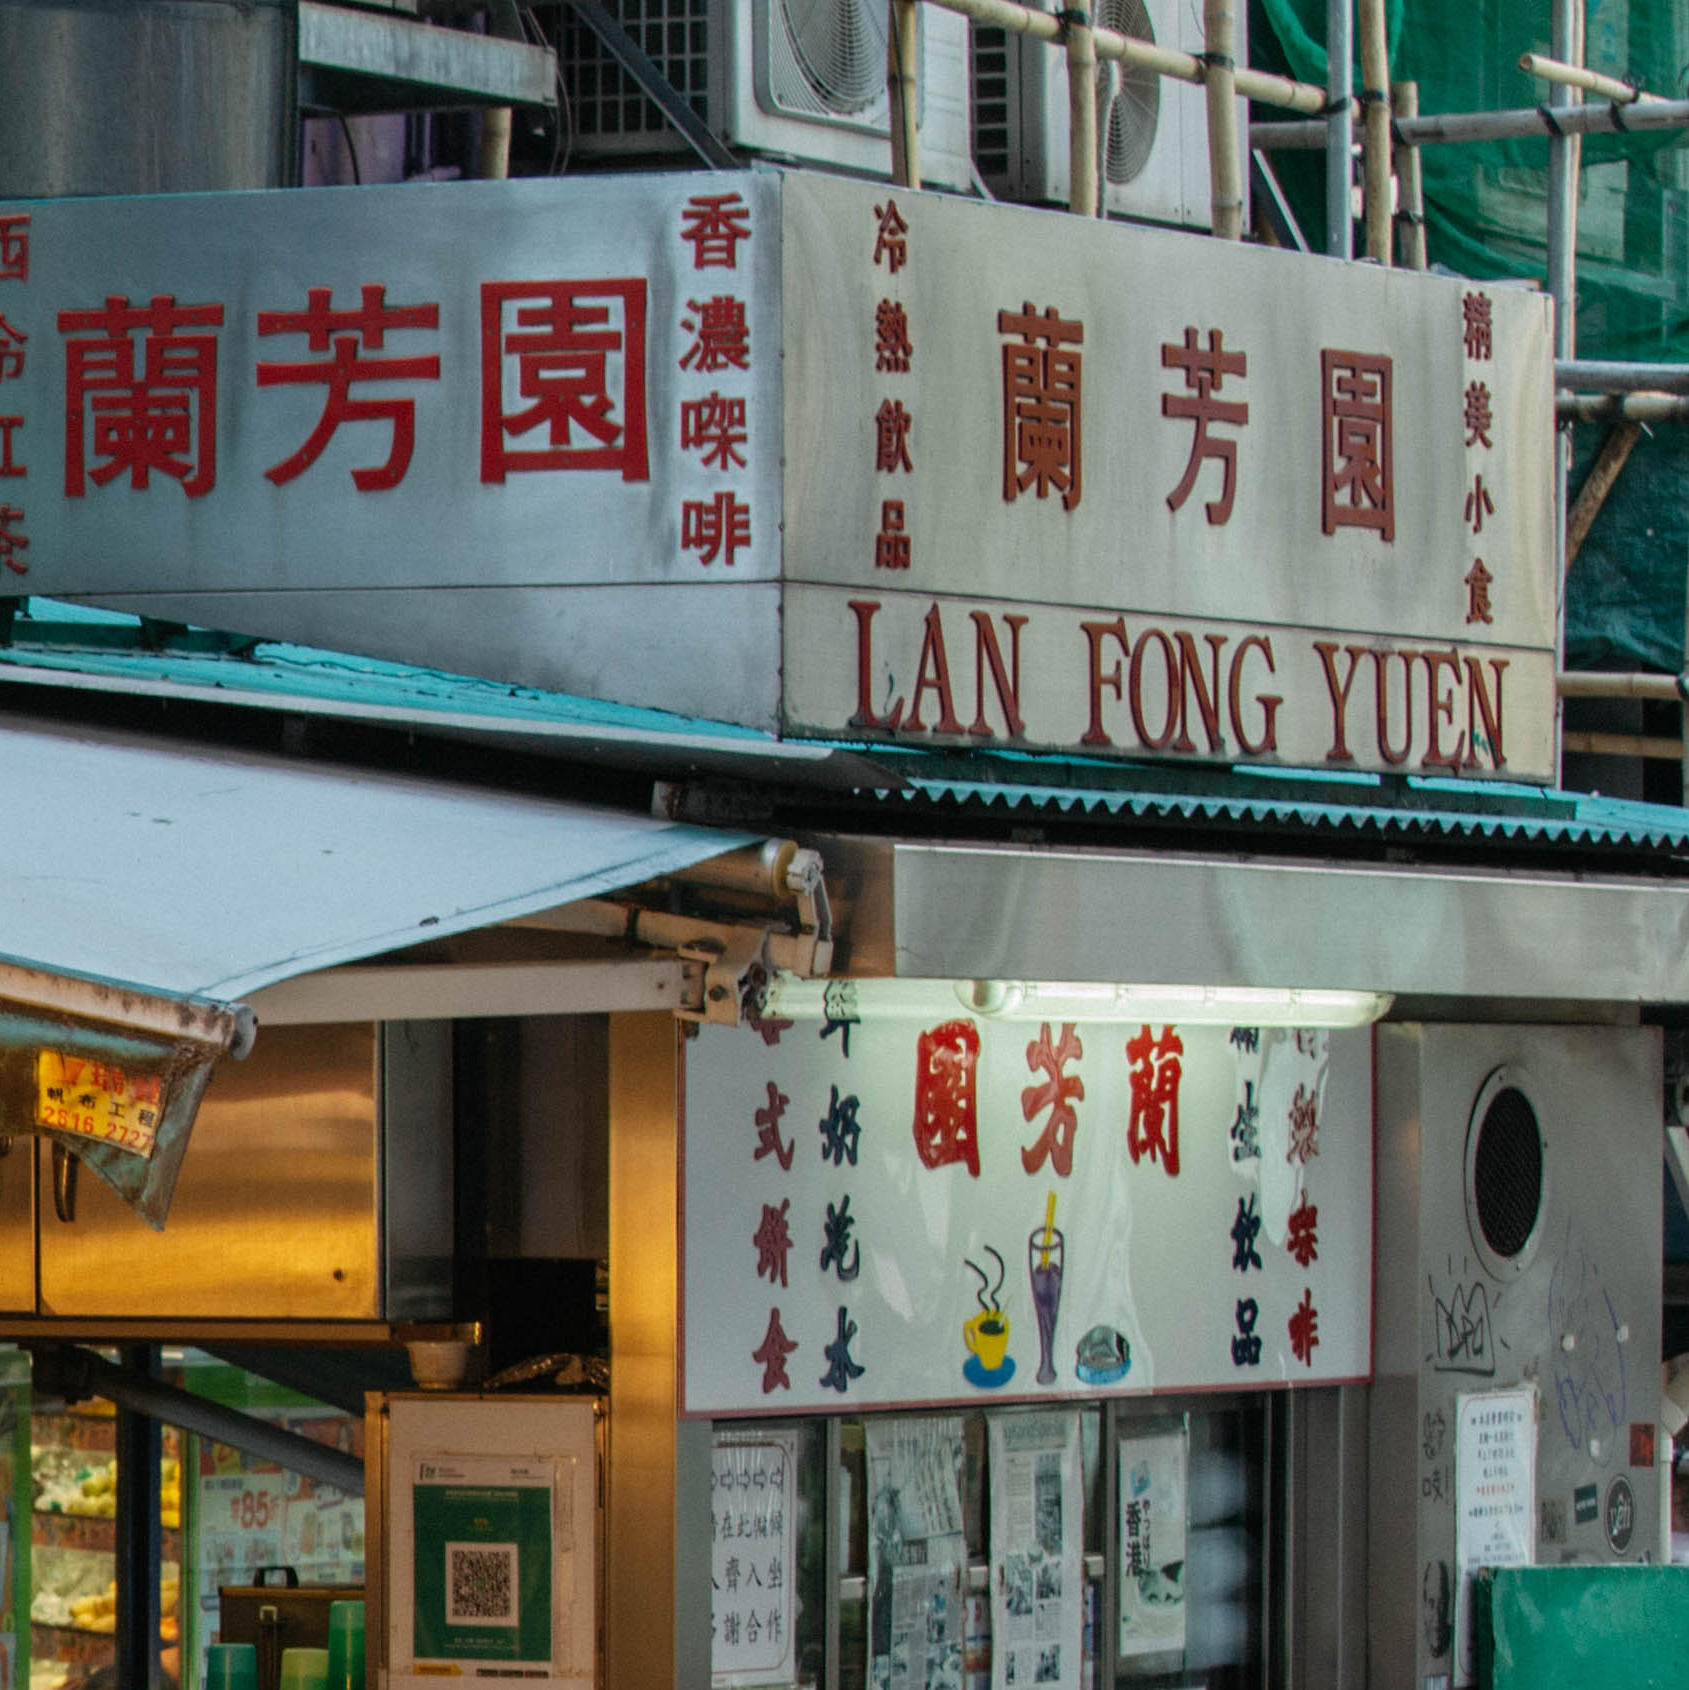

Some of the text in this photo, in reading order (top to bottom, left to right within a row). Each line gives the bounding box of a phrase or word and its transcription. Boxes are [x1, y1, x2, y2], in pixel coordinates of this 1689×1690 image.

[57, 277, 649, 498] 蘭芳園
[873, 199, 913, 570] 冷熱飲品
[998, 301, 1396, 543] 蘭芳園
[1463, 291, 1494, 626] 精美小食
[848, 599, 1510, 774] LAN FONG YUEN
[43, 1106, 153, 1149] 2816 2727
[47, 1087, 155, 1128] 帆布工程
[1126, 1501, 1143, 1577] 香港
